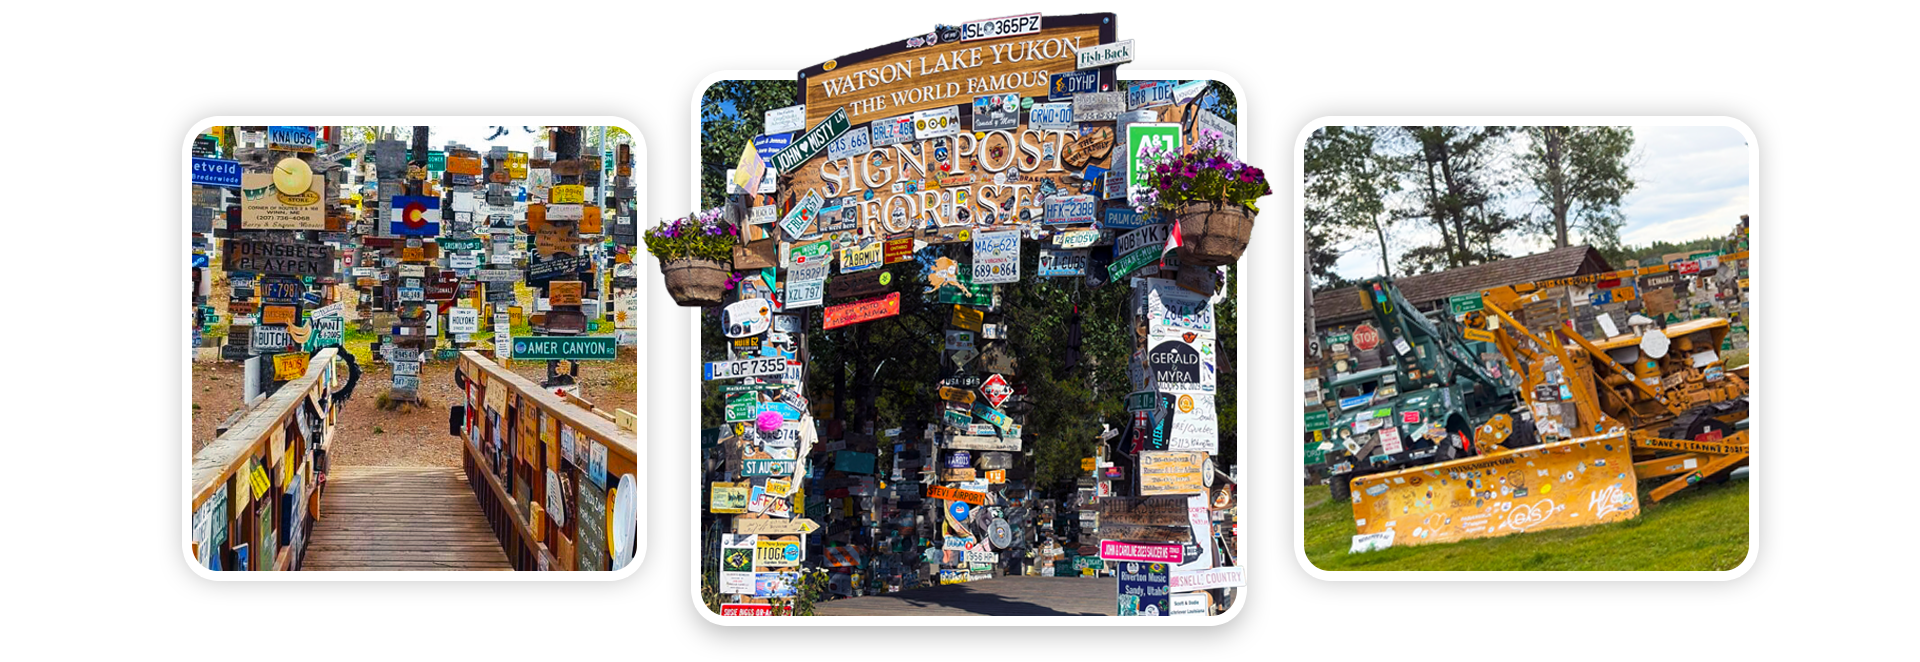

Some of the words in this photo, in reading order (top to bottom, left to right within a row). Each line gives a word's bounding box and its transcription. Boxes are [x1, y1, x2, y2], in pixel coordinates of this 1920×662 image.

[966, 26, 985, 43] SL
[1081, 46, 1130, 65] Fish-Back
[822, 61, 913, 98] WATSON
[920, 46, 985, 81] LAKE
[990, 37, 1082, 66] YUKON
[1067, 74, 1096, 93] DYHP
[849, 95, 888, 118] THE
[890, 81, 961, 108] WORLD
[966, 69, 1049, 95] FAMOUS
[1130, 89, 1147, 107] GR8
[272, 129, 290, 144] KNA
[293, 131, 313, 146] 056
[777, 144, 803, 173] JOHN
[807, 125, 835, 153] MISTY
[835, 112, 847, 128] LN
[829, 139, 847, 154] CXS
[850, 132, 867, 151] 663
[1078, 137, 1095, 149] THE
[193, 161, 236, 175] etveld
[820, 140, 927, 200] SIGN
[946, 128, 1079, 176] POST
[857, 184, 1034, 242] FOREST
[1107, 212, 1130, 225] PALM
[1141, 225, 1158, 244] YK
[240, 257, 319, 275] PLAYPEN
[974, 264, 991, 278] 689
[1000, 262, 1017, 277] 864
[804, 285, 820, 299] 797
[452, 316, 476, 325] HOLYOKE
[1164, 304, 1183, 322] 284
[1354, 332, 1377, 344] STOP
[527, 343, 558, 355] AMER
[563, 342, 606, 356] CANYON
[1309, 342, 1319, 357] 9
[1151, 352, 1199, 365] GERALD
[713, 362, 722, 378] L
[731, 361, 749, 376] QF
[751, 358, 786, 374] 7355
[1157, 370, 1192, 382] MYRA
[1651, 439, 1673, 448] DAVE
[746, 462, 757, 475] ST
[927, 486, 949, 498] STEVI
[952, 489, 983, 503] AIRPORT
[1121, 571, 1147, 582] Riverton
[1147, 573, 1167, 584] Music
[1205, 570, 1242, 584] COUNTRY
[1125, 584, 1147, 597] Sandy,
[1147, 585, 1163, 596] Utah
